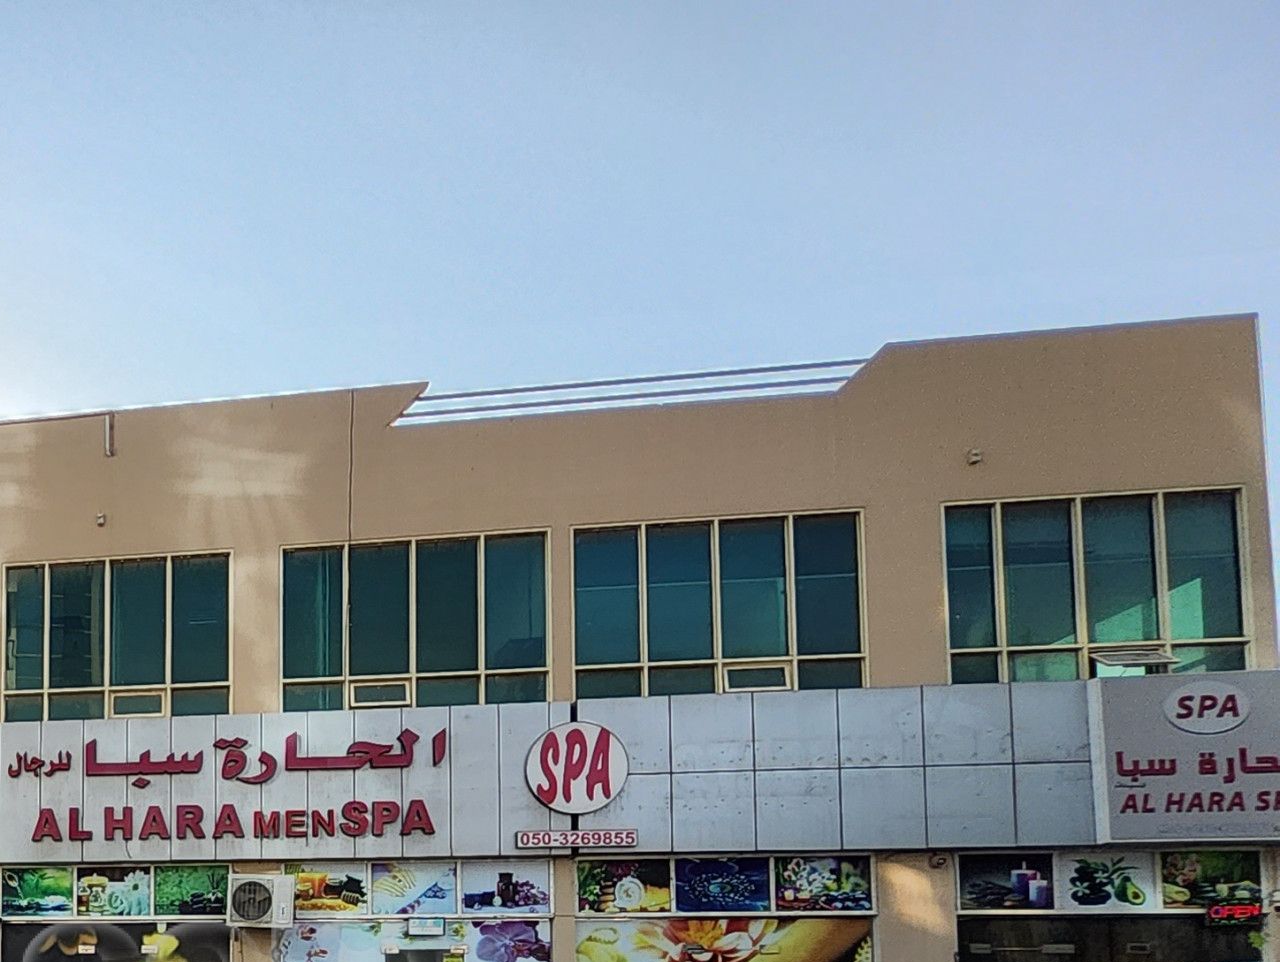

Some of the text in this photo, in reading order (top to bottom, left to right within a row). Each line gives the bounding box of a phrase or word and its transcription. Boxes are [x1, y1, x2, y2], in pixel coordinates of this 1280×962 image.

[1175, 694, 1240, 719] SPA
[7, 727, 447, 788] الحارة سبا للرجال
[536, 727, 611, 805] SPA
[1114, 751, 1177, 782] سبا
[1119, 793, 1156, 814] AL
[1164, 791, 1246, 813] HARA
[31, 807, 94, 842] AL
[103, 804, 246, 840] HARA
[520, 831, 636, 847] 050-3269855
